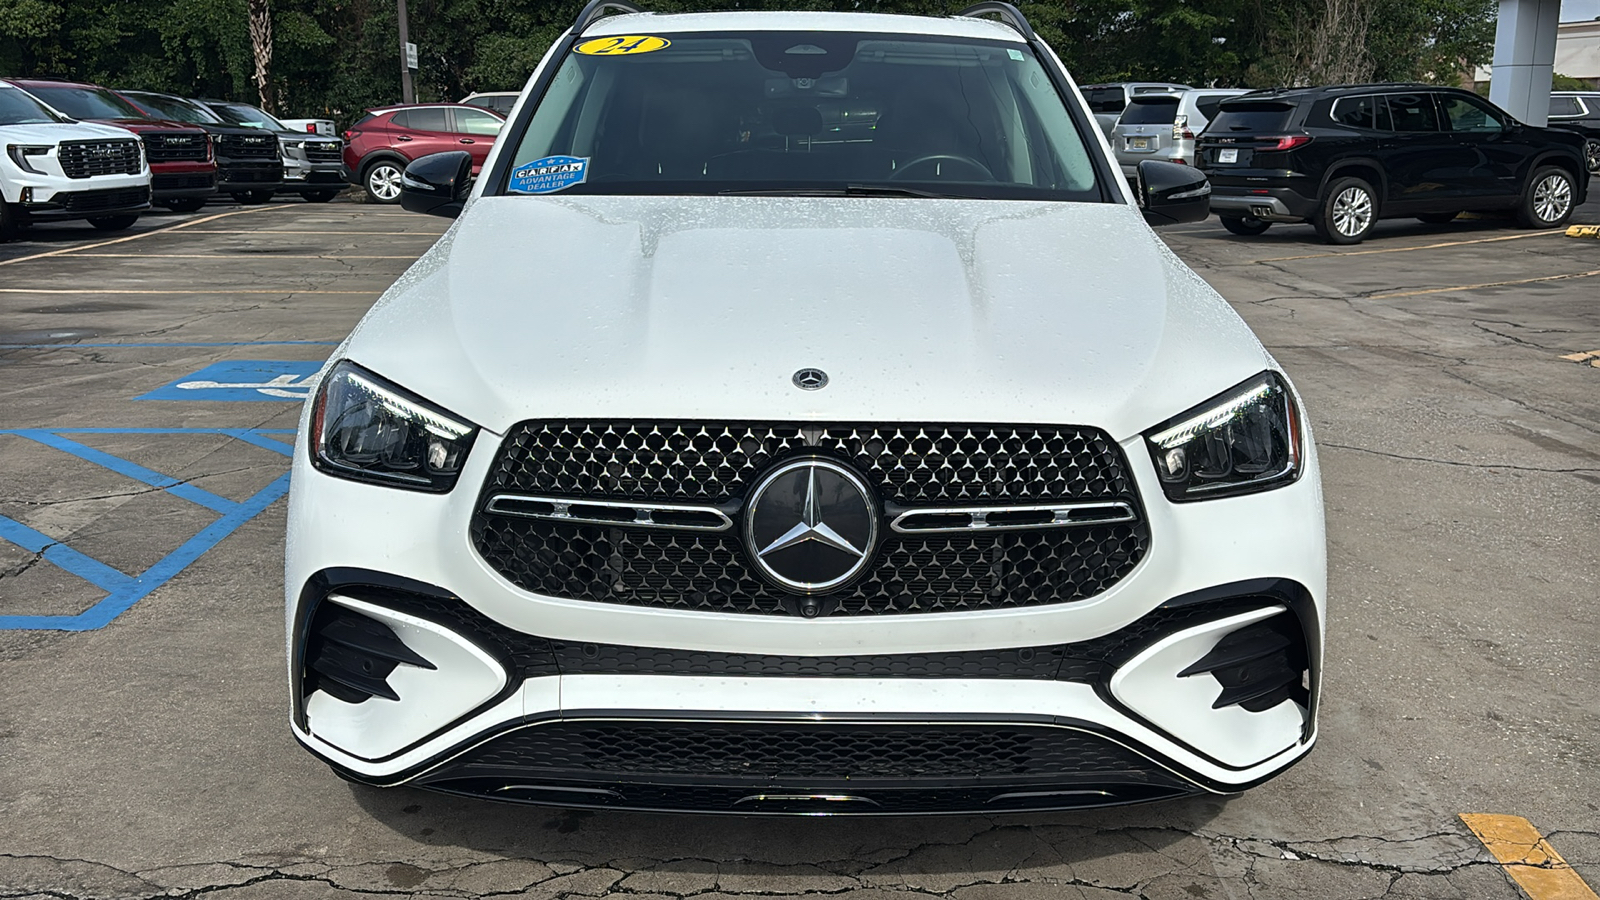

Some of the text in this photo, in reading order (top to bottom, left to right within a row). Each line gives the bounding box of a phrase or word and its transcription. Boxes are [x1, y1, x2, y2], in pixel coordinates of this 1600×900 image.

[593, 37, 650, 53] 24
[516, 164, 581, 178] CARFAX
[519, 173, 575, 185] ADVANTAGE
[527, 181, 564, 191] DEALER
